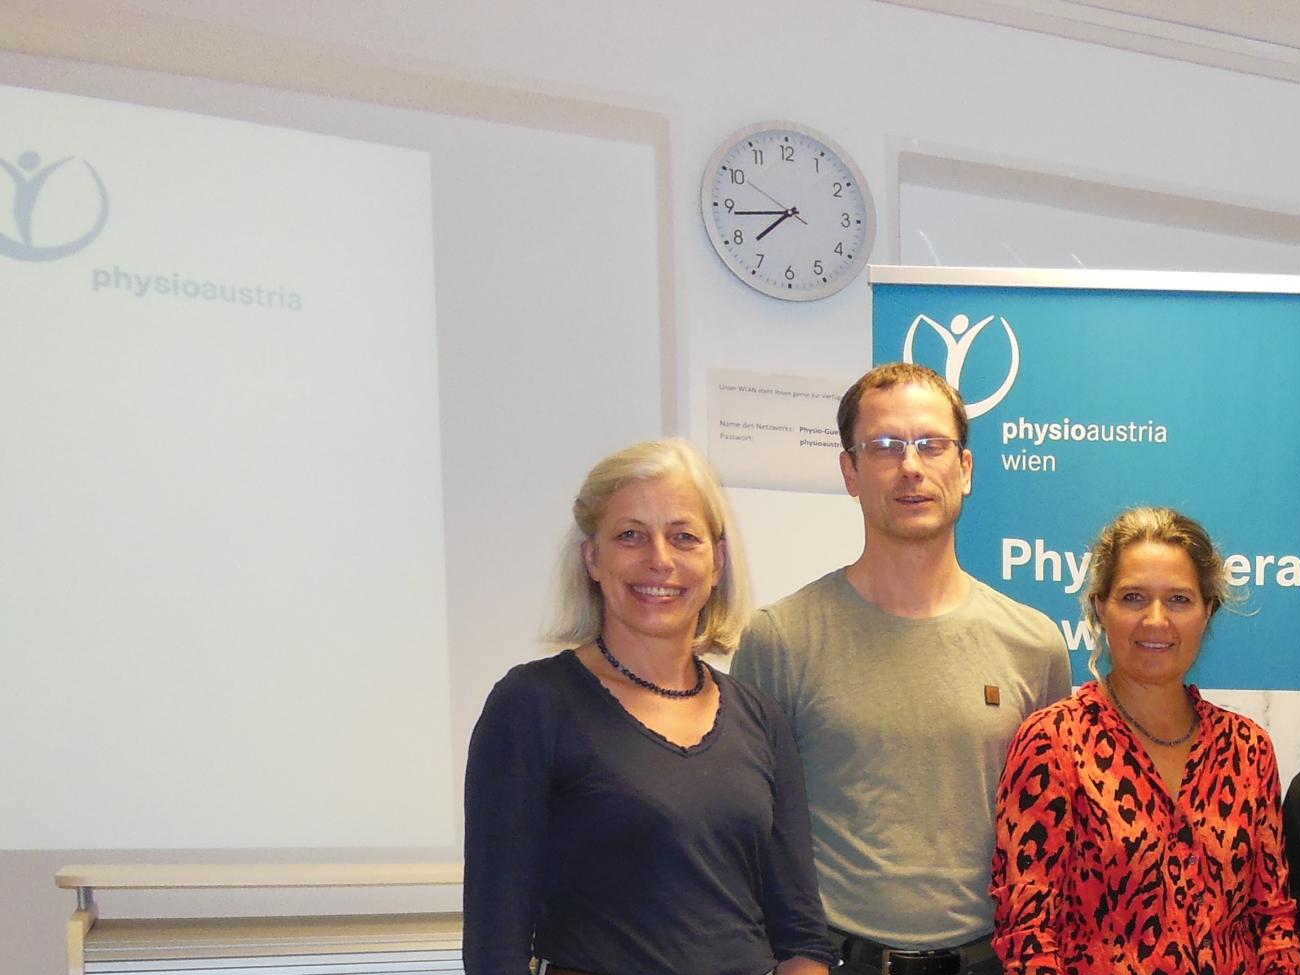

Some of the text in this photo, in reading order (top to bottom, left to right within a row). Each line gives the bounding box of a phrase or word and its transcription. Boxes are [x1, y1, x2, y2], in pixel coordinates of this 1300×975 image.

[752, 149, 764, 166] 11
[780, 145, 795, 162] 12
[814, 157, 819, 173] 1
[729, 168, 745, 185] 10
[832, 182, 842, 198] 2
[724, 198, 735, 214] 9
[841, 213, 850, 228] 3
[733, 230, 744, 245] 8
[834, 242, 843, 256] 4
[756, 253, 765, 268] 7
[813, 260, 823, 275] 5
[785, 265, 795, 280] 6
[92, 265, 303, 311] physioaustria
[738, 385, 757, 393] WLAN
[719, 420, 741, 428] Name
[799, 426, 840, 436] Physio-Gue
[1002, 416, 1167, 446] physioaustria
[1001, 449, 1056, 472] wien
